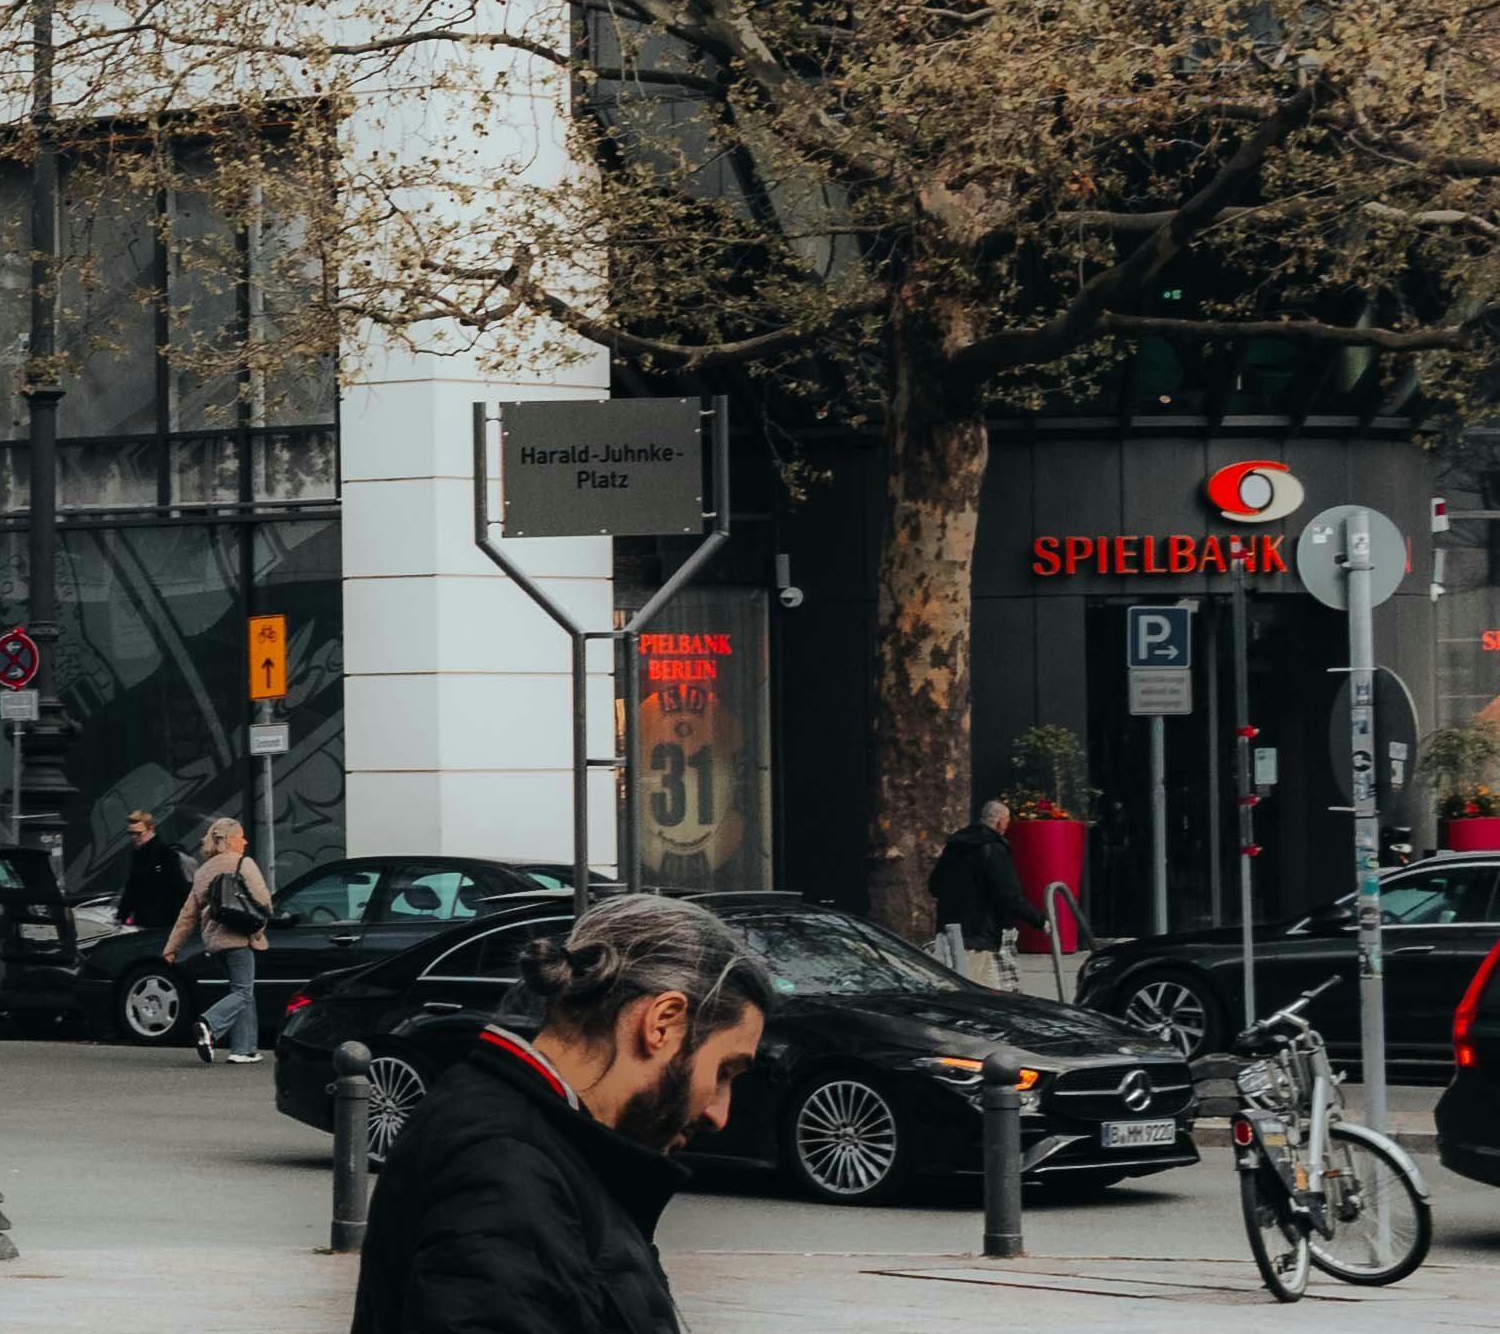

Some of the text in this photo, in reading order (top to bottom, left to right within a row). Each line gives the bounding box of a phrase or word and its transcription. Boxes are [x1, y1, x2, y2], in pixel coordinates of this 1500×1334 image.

[520, 444, 684, 465] Harald-Juhnke-
[577, 470, 629, 489] Platz
[1032, 534, 1288, 576] SPIELBANK
[638, 634, 732, 655] PIELBANK
[1138, 615, 1171, 660] P
[648, 660, 717, 679] BERLIN
[651, 740, 714, 827] 31
